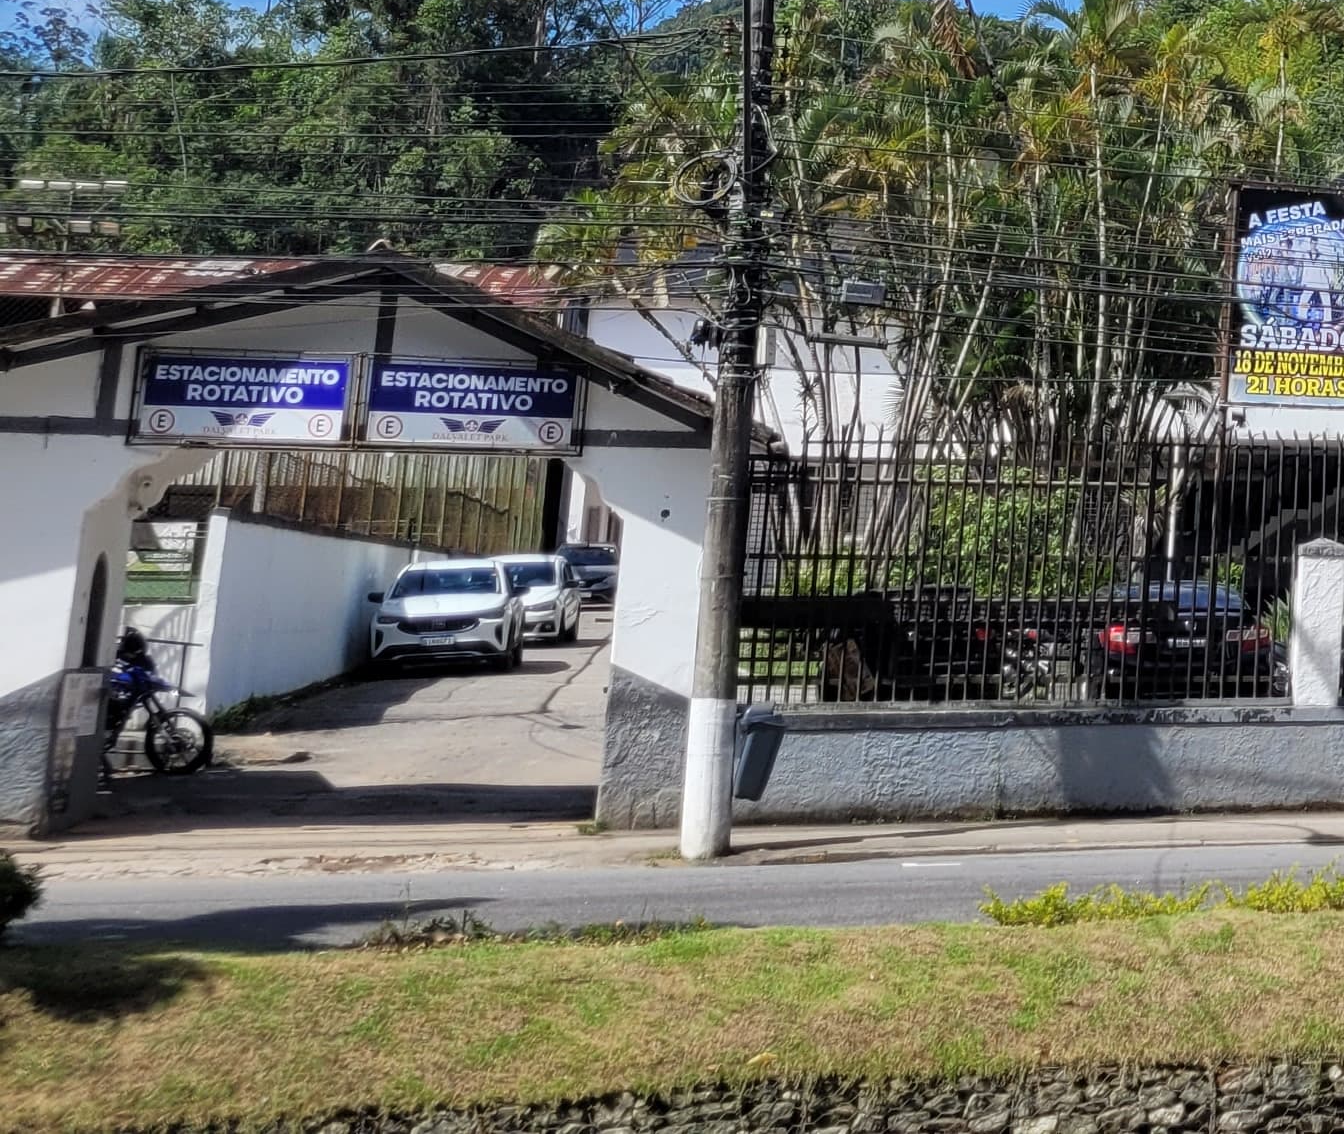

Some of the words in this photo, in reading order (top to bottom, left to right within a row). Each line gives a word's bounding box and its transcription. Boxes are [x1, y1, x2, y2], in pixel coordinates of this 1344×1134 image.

[1248, 213, 1262, 229] A
[1265, 201, 1326, 224] FESTA
[1241, 233, 1276, 248] MAIS
[1254, 351, 1275, 374] DE
[155, 365, 340, 385] ESTACIONAMENTO
[381, 371, 568, 394] ESTACIONAMENTO
[186, 384, 304, 404] ROTATIVO
[1246, 376, 1270, 396] 21
[414, 390, 533, 410] ROTATIVO
